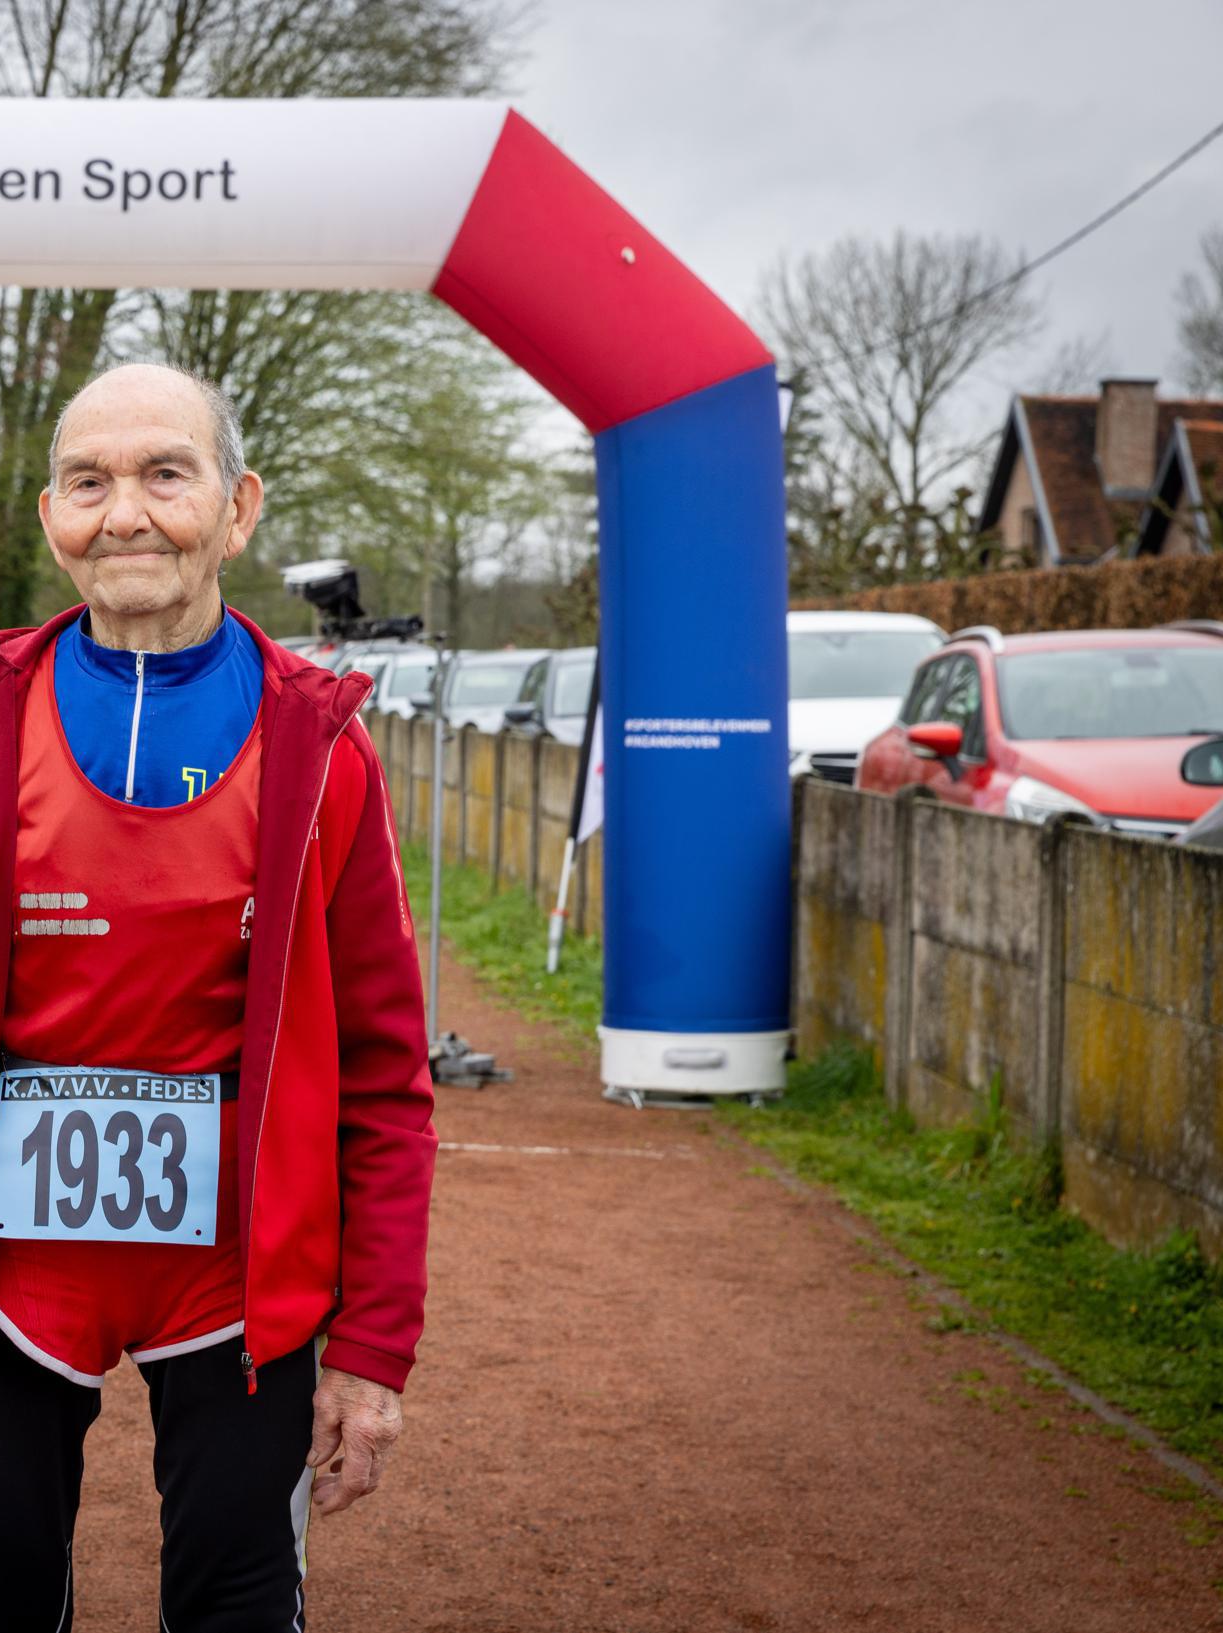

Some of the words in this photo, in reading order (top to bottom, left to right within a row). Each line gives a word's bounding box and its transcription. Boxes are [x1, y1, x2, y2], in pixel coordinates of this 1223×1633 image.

[83, 157, 238, 213] Sport
[4, 1077, 115, 1099] K.A.V.V.V.
[136, 1078, 211, 1101] FEDES
[21, 1109, 188, 1232] 1933
